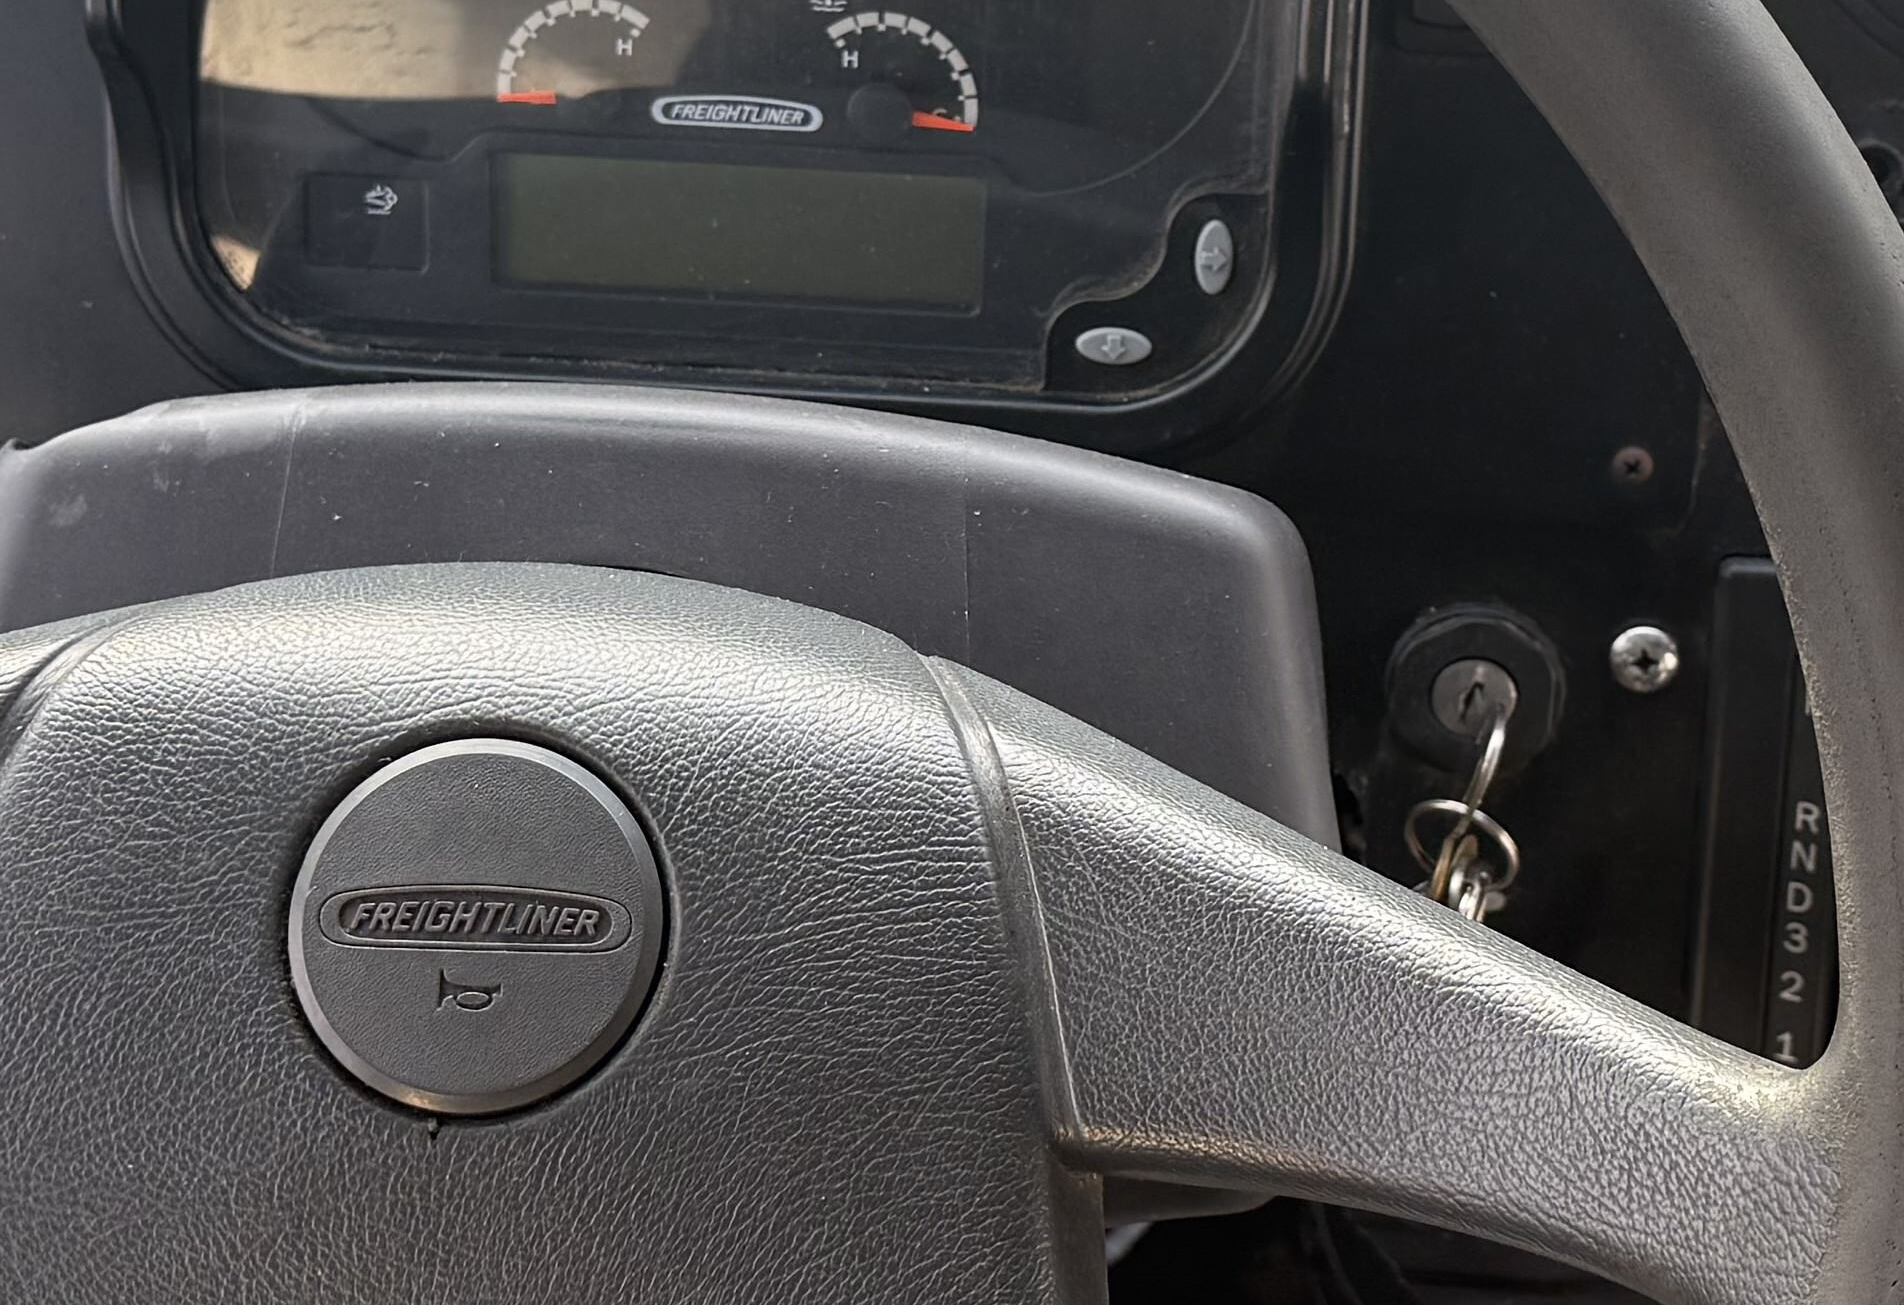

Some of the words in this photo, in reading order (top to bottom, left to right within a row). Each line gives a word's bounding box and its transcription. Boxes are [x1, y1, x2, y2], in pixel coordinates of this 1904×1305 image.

[616, 38, 633, 56] H
[841, 50, 859, 69] H
[670, 103, 804, 126] FREIGHTLINER
[1796, 801, 1820, 834] R
[1790, 841, 1818, 873] N
[1786, 881, 1813, 914] D
[350, 899, 600, 937] FREIGHTLINER
[1783, 922, 1810, 955] 3
[1779, 970, 1806, 1003] 2
[1775, 1032, 1797, 1064] 1
